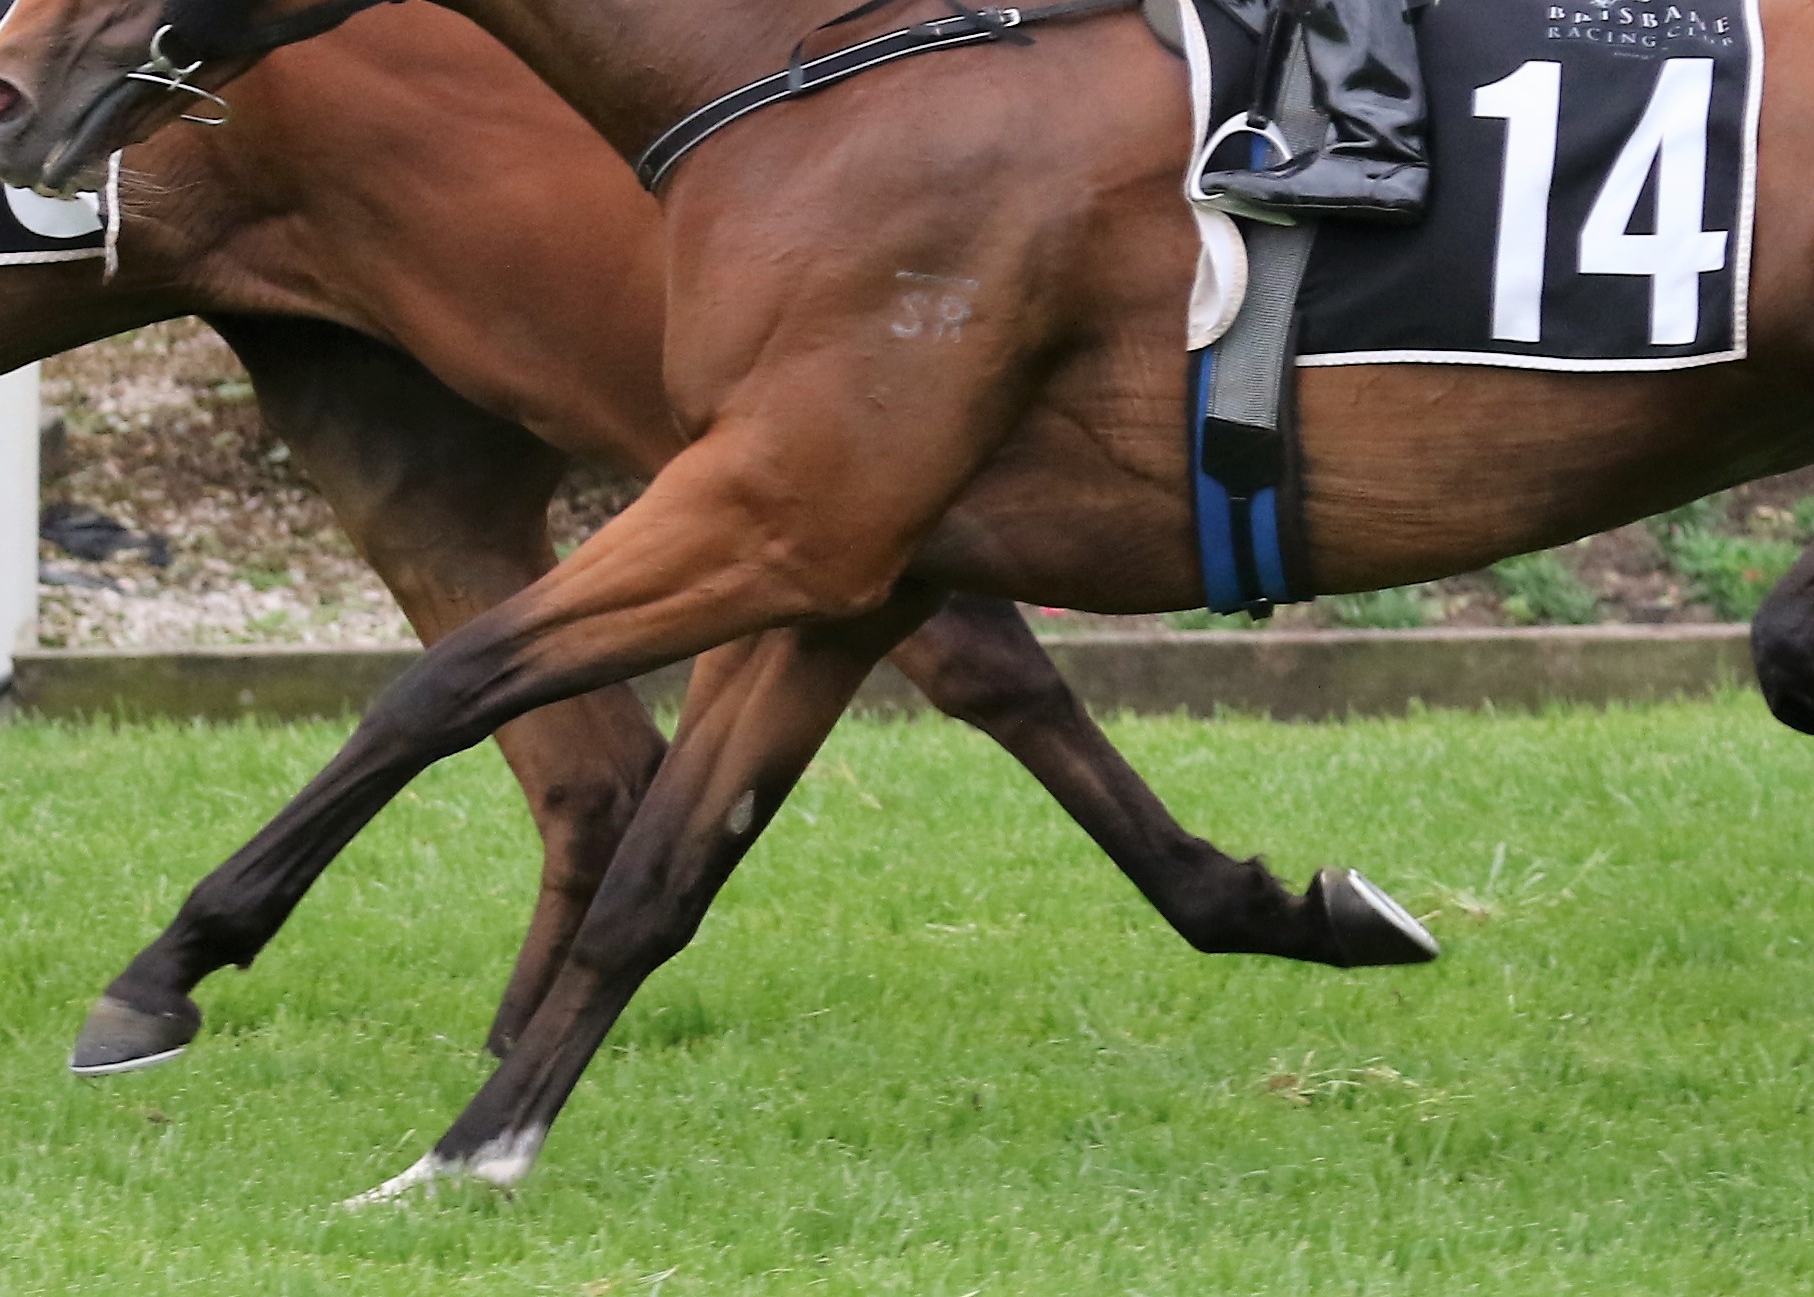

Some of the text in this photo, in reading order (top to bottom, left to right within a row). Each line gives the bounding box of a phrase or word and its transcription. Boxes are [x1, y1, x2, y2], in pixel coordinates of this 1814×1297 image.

[1547, 5, 1731, 34] BRISBANE
[1548, 26, 1657, 48] RACING
[1471, 57, 1729, 346] 14
